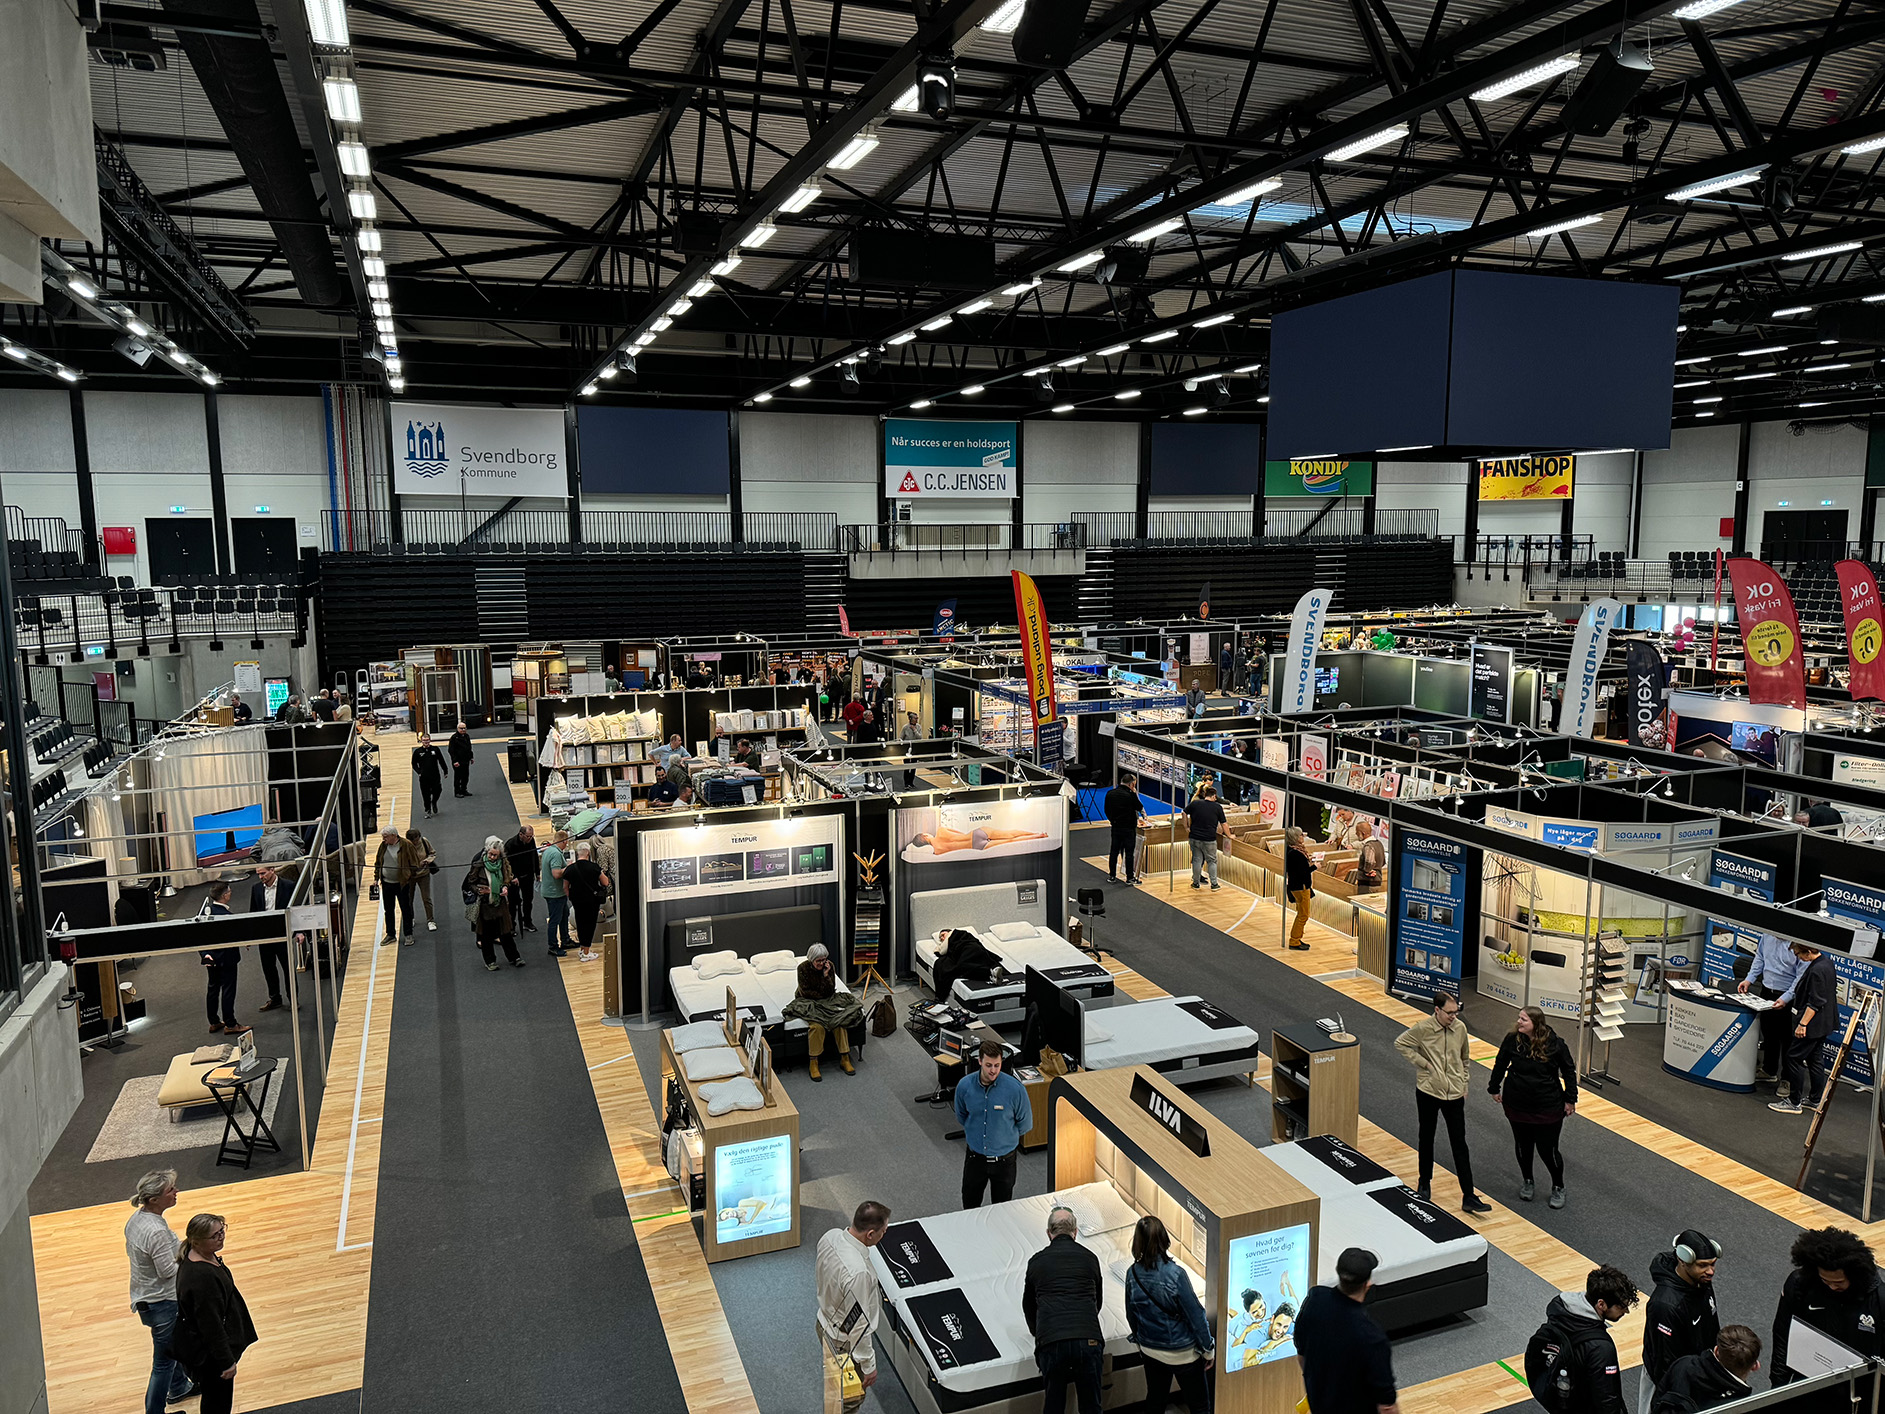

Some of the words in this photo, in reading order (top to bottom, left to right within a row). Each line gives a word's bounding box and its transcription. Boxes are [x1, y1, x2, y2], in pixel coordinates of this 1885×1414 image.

[891, 436, 909, 447] Når
[910, 438, 940, 448] succes
[942, 440, 952, 448] er
[954, 440, 965, 448] en
[966, 438, 1011, 451] holdsport
[460, 446, 558, 470] Svendborg
[460, 466, 517, 478] Kommune
[1289, 461, 1343, 476] KONDI
[1482, 457, 1571, 478] FANSHOP
[1296, 596, 1321, 706] SVENDBORG
[1062, 658, 1086, 667] LOKAL
[968, 814, 992, 822] TEMPUR
[731, 835, 758, 844] TEMPUR
[1614, 832, 1657, 840] SØGAARD
[1678, 828, 1709, 839] SØGAARD
[1406, 837, 1453, 853] SØGAARD
[1715, 858, 1762, 879] SØGAARD
[1827, 886, 1883, 909] SØGAARD
[1672, 956, 1686, 965] FØR
[1830, 954, 1846, 965] NYE
[1847, 957, 1873, 974] LÅGER
[1853, 968, 1863, 979] på
[1865, 973, 1869, 981] 1
[1486, 983, 1494, 992] 70
[1494, 987, 1505, 996] 444
[1506, 991, 1517, 1000] 222
[1540, 999, 1581, 1013] SKFN.DK
[1711, 1026, 1739, 1056] SØGAARD
[1314, 1055, 1336, 1065] TEMPUR
[1148, 1091, 1182, 1135] ILVA
[1186, 1200, 1207, 1223] TEMPUR
[1245, 1248, 1270, 1259] søvnen
[1270, 1245, 1280, 1253] for
[1280, 1241, 1295, 1252] dig?
[1255, 1237, 1273, 1248] Hvad
[899, 1240, 919, 1265] TEMPUR
[940, 1313, 963, 1342] TEMPUR
